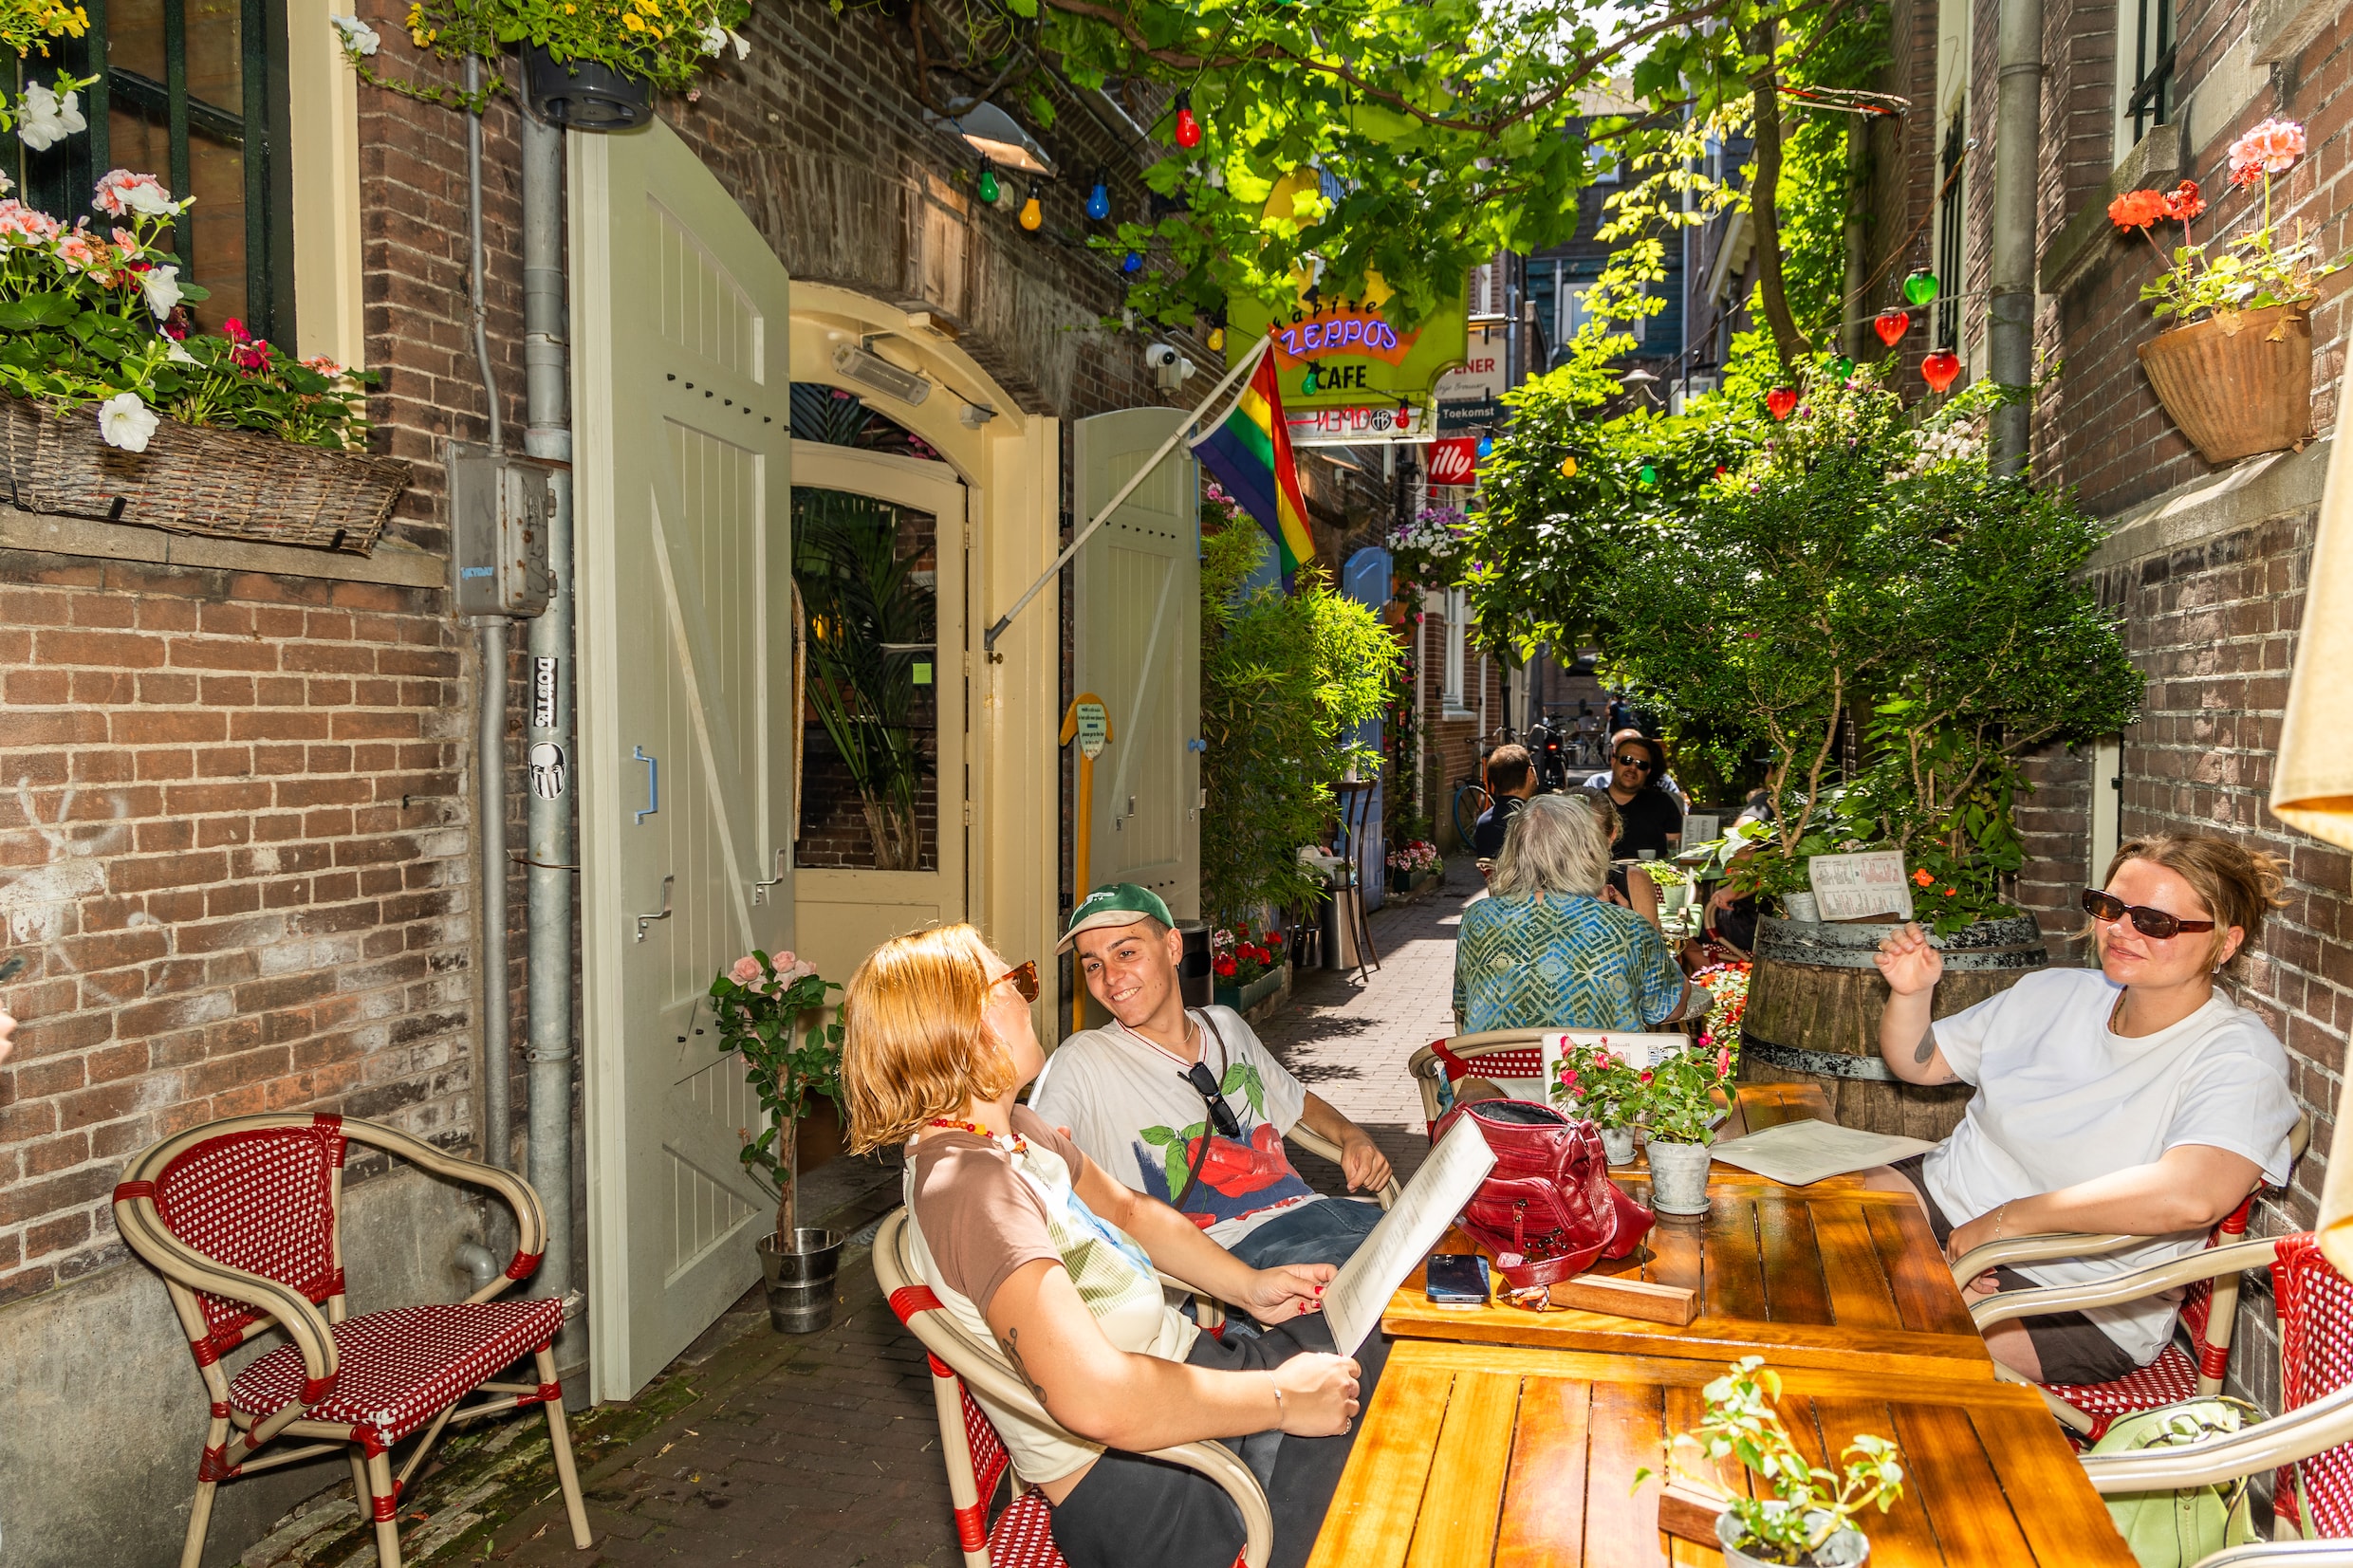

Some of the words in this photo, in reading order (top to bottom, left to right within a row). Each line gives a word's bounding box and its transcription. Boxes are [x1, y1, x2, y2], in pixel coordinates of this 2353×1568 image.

[1281, 320, 1398, 356] ZEPPOS
[1316, 365, 1367, 390] CAFE
[1442, 406, 1494, 419] Toekomst
[1431, 445, 1472, 481] illy
